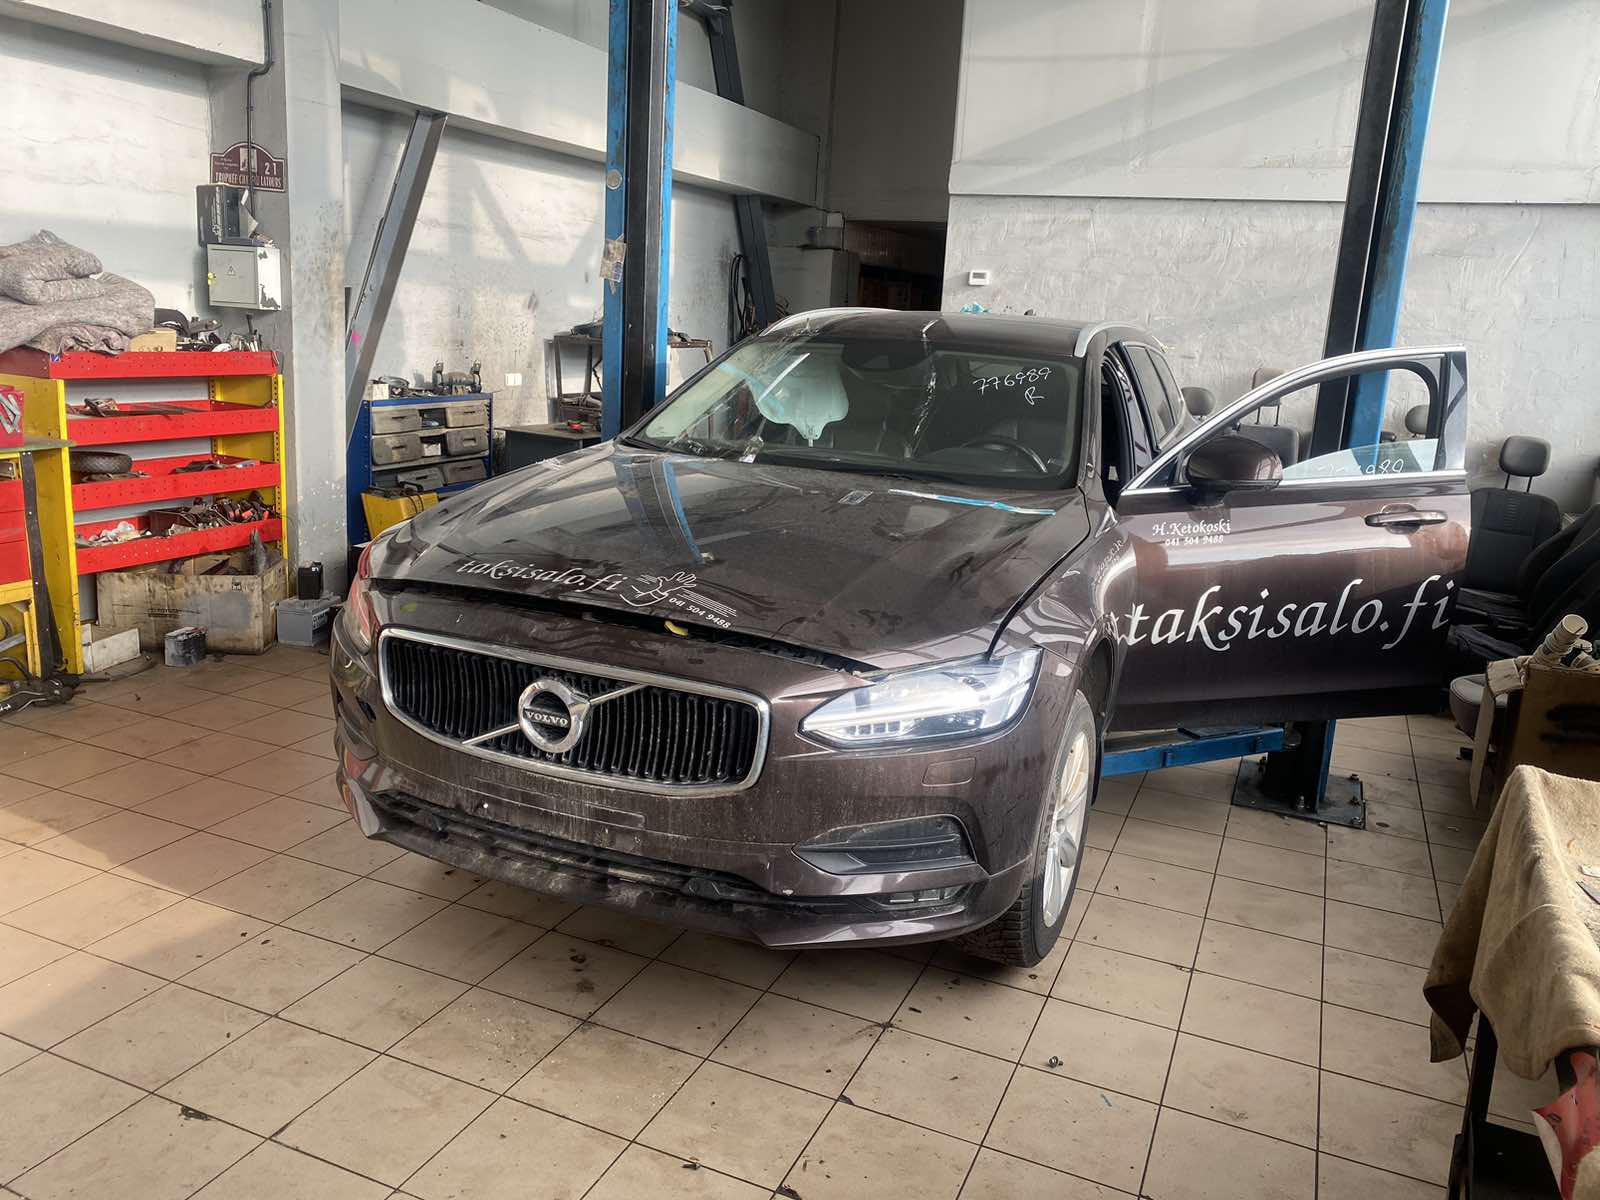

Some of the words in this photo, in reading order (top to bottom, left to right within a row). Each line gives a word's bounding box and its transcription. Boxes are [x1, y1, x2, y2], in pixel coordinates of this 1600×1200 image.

[264, 162, 277, 175] 21
[973, 366, 1052, 396] 776989
[1152, 518, 1231, 537] H.Ketokoski
[456, 559, 629, 593] taksisalo.fi
[668, 597, 686, 607] 041
[686, 604, 706, 616] 504
[705, 613, 731, 629] 9488
[1125, 574, 1455, 652] taksisalo.fi
[525, 710, 569, 728] VOLVO
